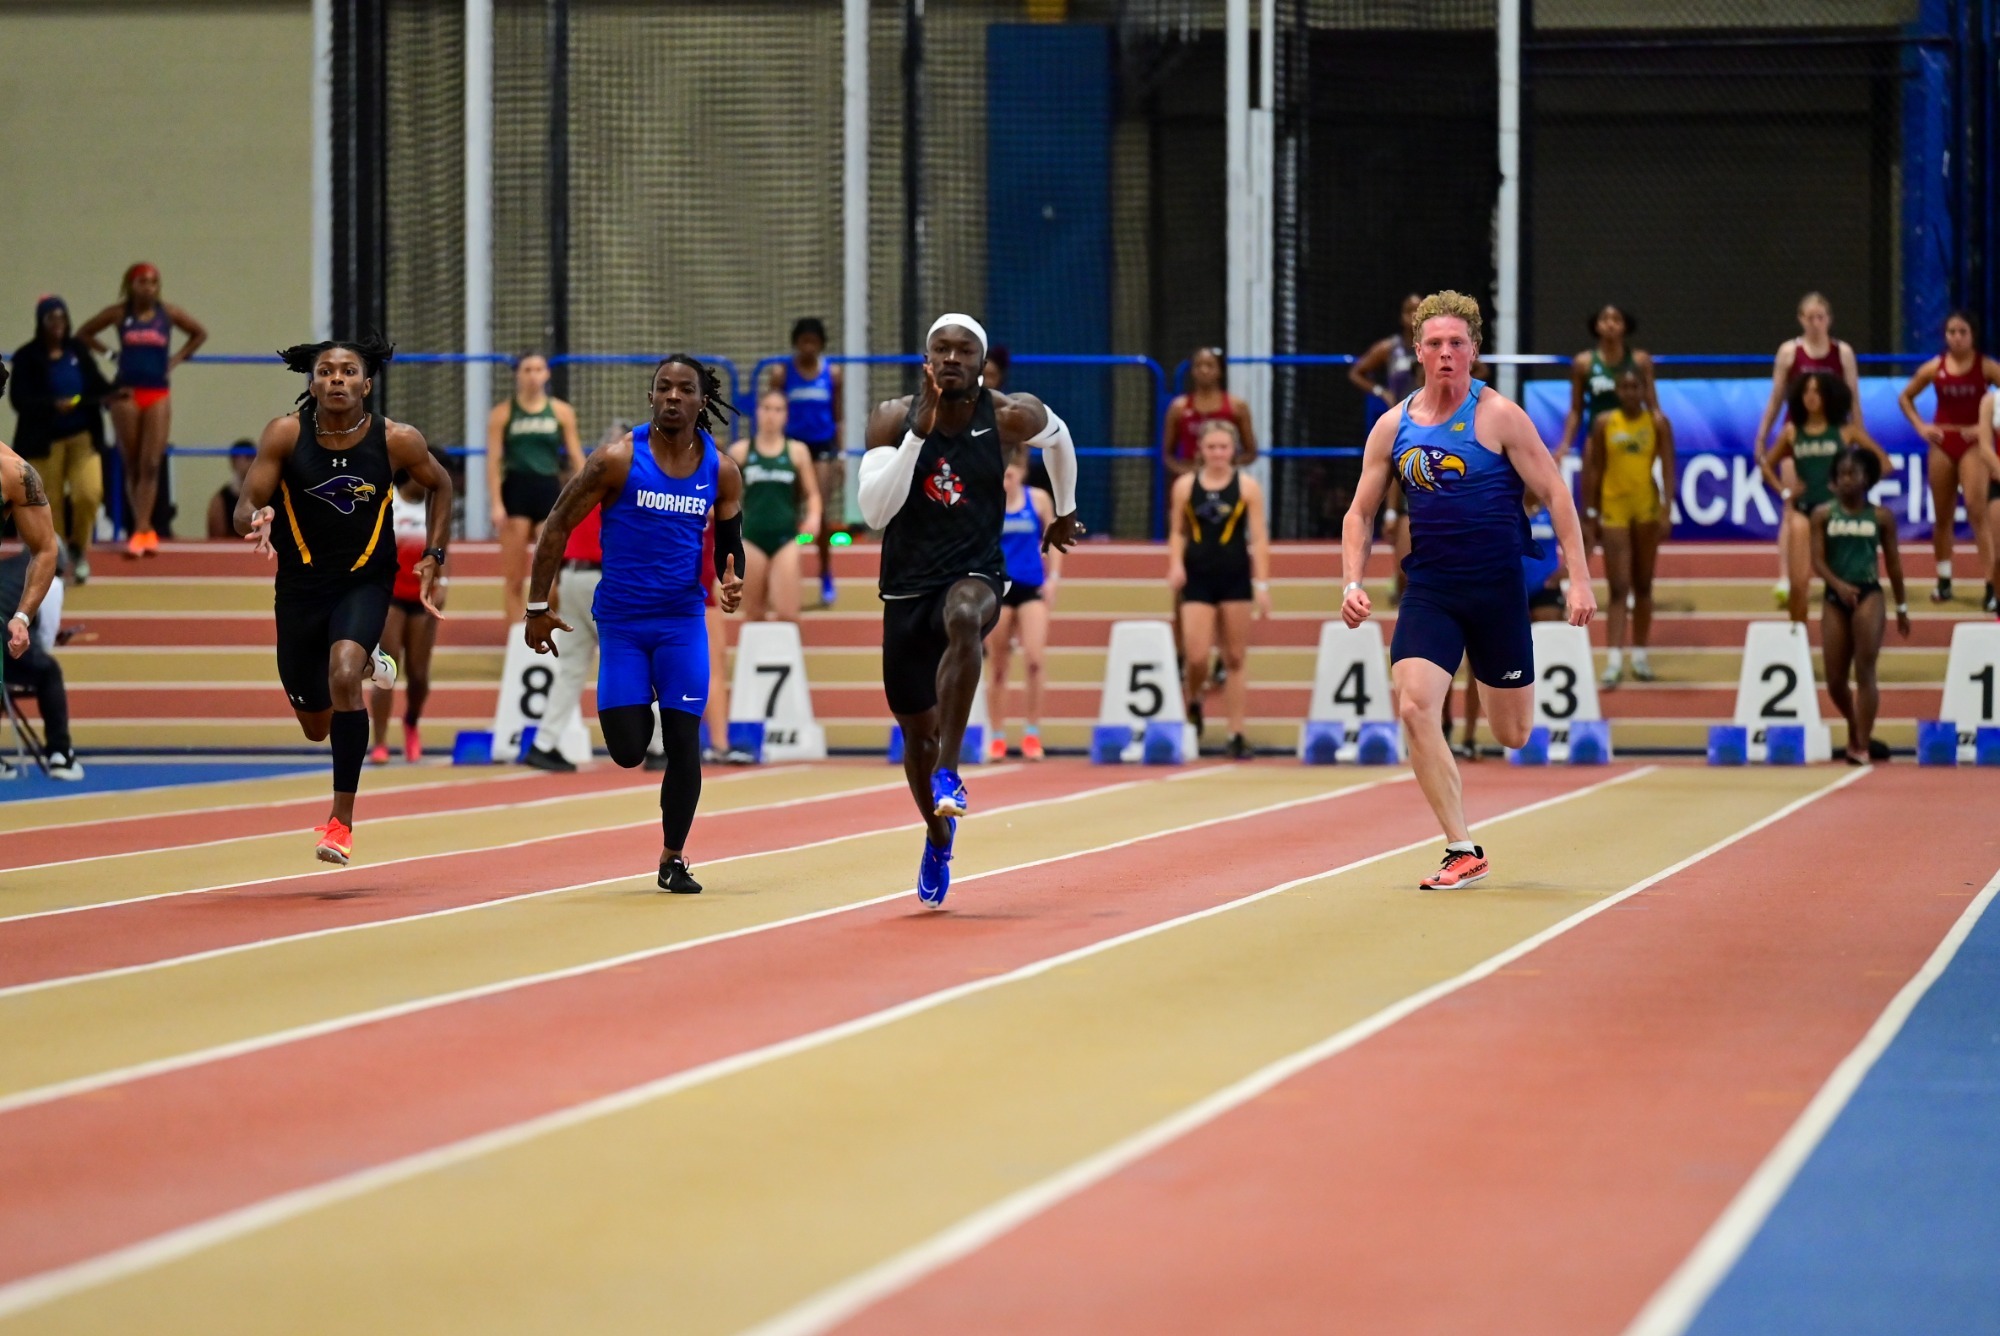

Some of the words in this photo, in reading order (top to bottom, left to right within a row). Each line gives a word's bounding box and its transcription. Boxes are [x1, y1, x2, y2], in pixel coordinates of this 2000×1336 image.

[637, 489, 707, 515] VOORHEES
[520, 665, 554, 720] 8
[756, 664, 791, 718] 7
[1128, 663, 1164, 718] 5
[1333, 661, 1371, 716] 4
[1541, 664, 1578, 719] 3
[1761, 663, 1797, 718] 2
[1969, 665, 1993, 719] 1
